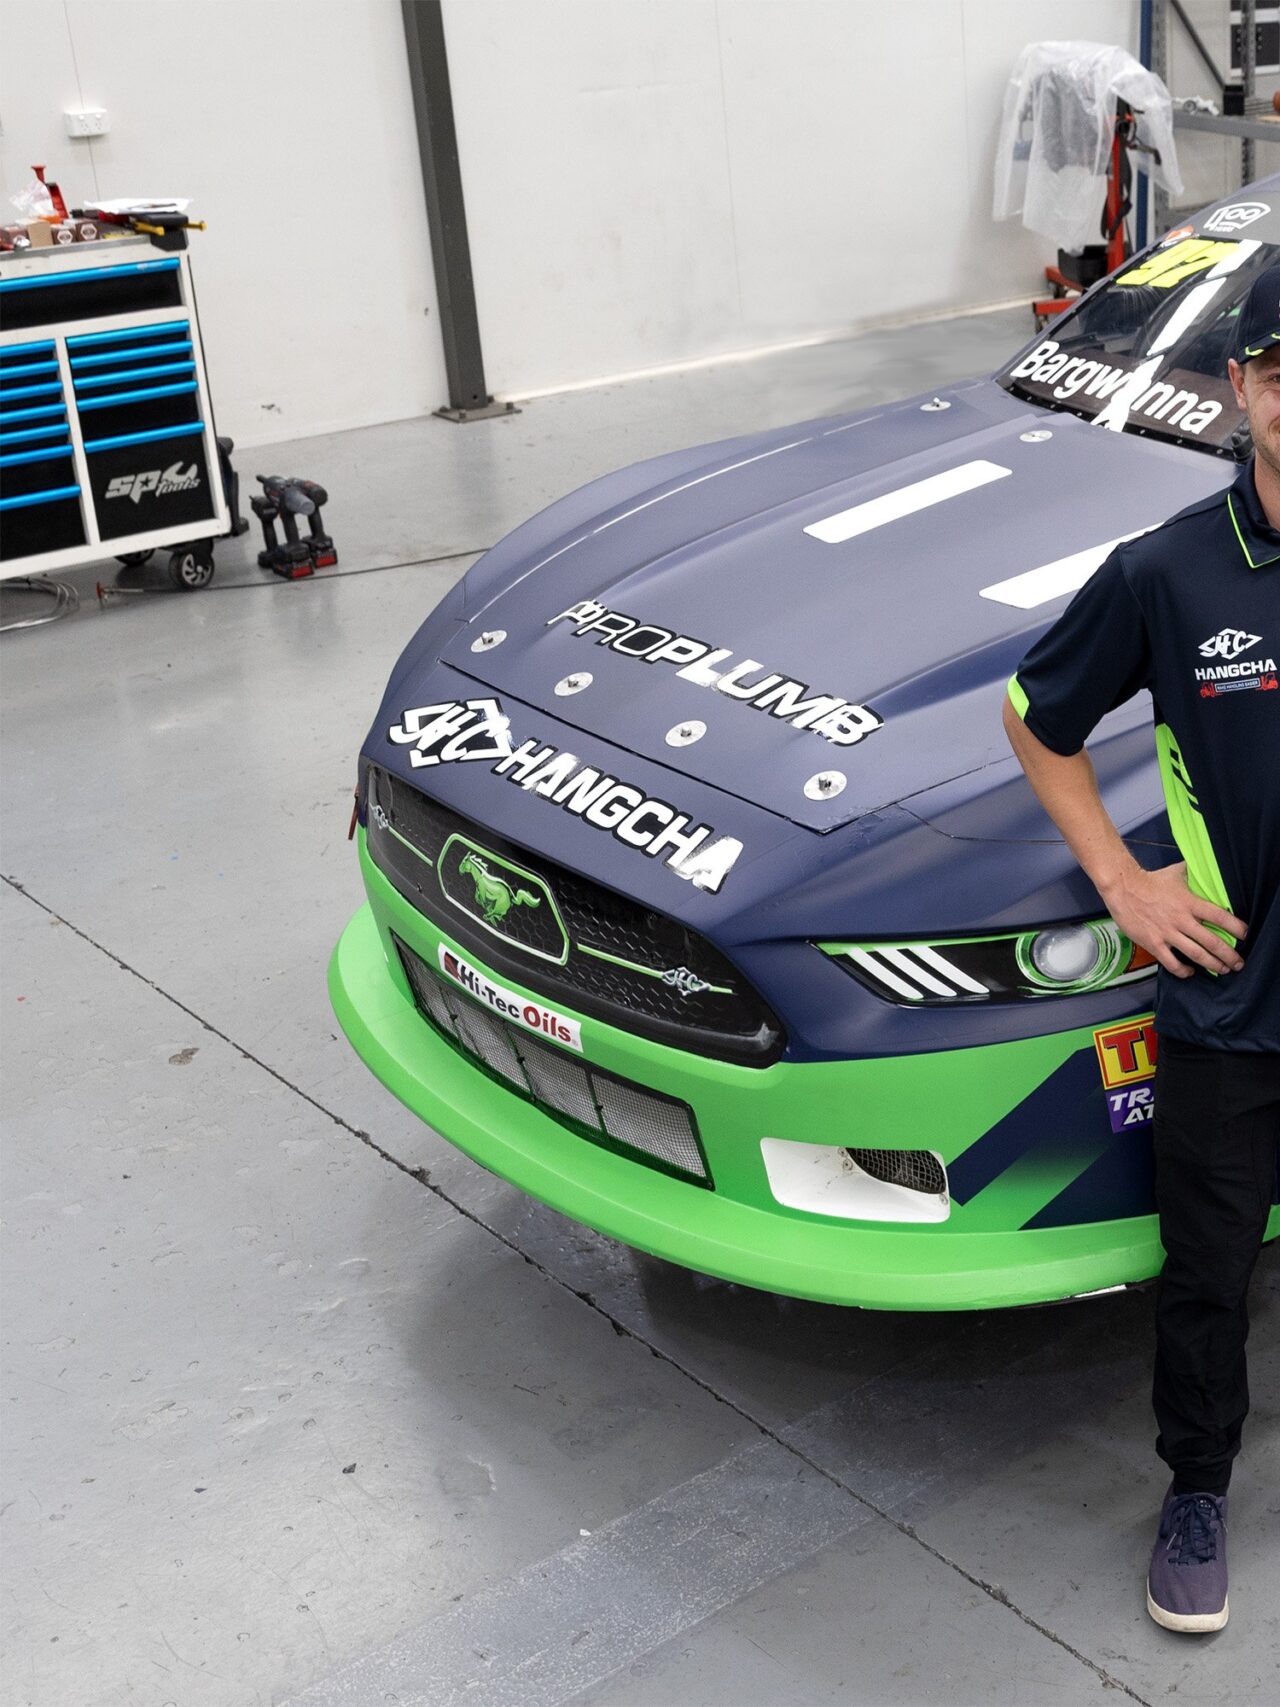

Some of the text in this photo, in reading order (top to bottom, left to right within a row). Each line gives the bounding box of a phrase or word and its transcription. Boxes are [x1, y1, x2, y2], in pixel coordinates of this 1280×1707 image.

[1010, 340, 1223, 435] Bargwnna
[546, 599, 885, 745] PROPLUMB
[1194, 658, 1278, 681] HANGCHA
[494, 740, 745, 892] HANGCHA
[459, 964, 572, 1043] Hi-Tec Oils
[1109, 1087, 1154, 1112] TR
